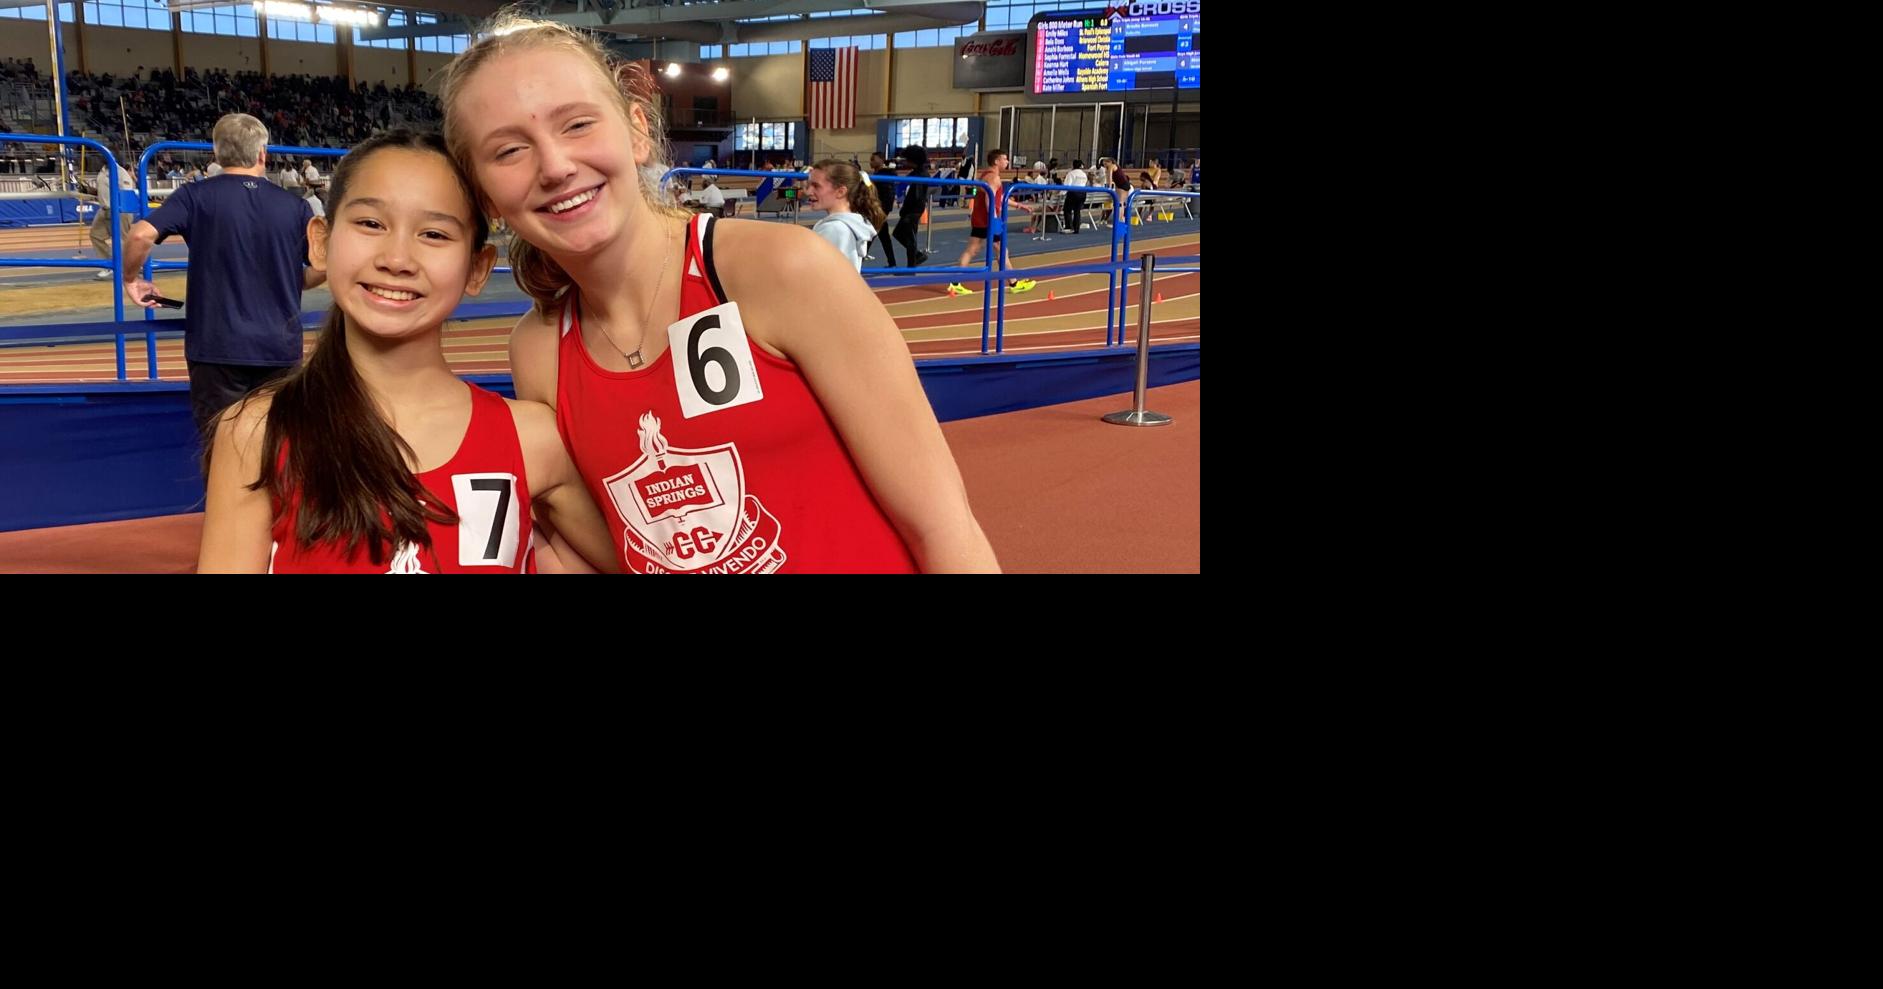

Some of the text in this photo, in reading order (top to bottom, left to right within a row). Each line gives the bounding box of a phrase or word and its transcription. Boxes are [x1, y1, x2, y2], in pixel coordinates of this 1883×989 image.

[1038, 21, 1048, 29] Girls
[1058, 20, 1072, 28] Meter
[687, 314, 741, 405] 6
[645, 474, 694, 495] INDIAN
[646, 485, 706, 508] SPRINGS
[470, 478, 511, 560] 7
